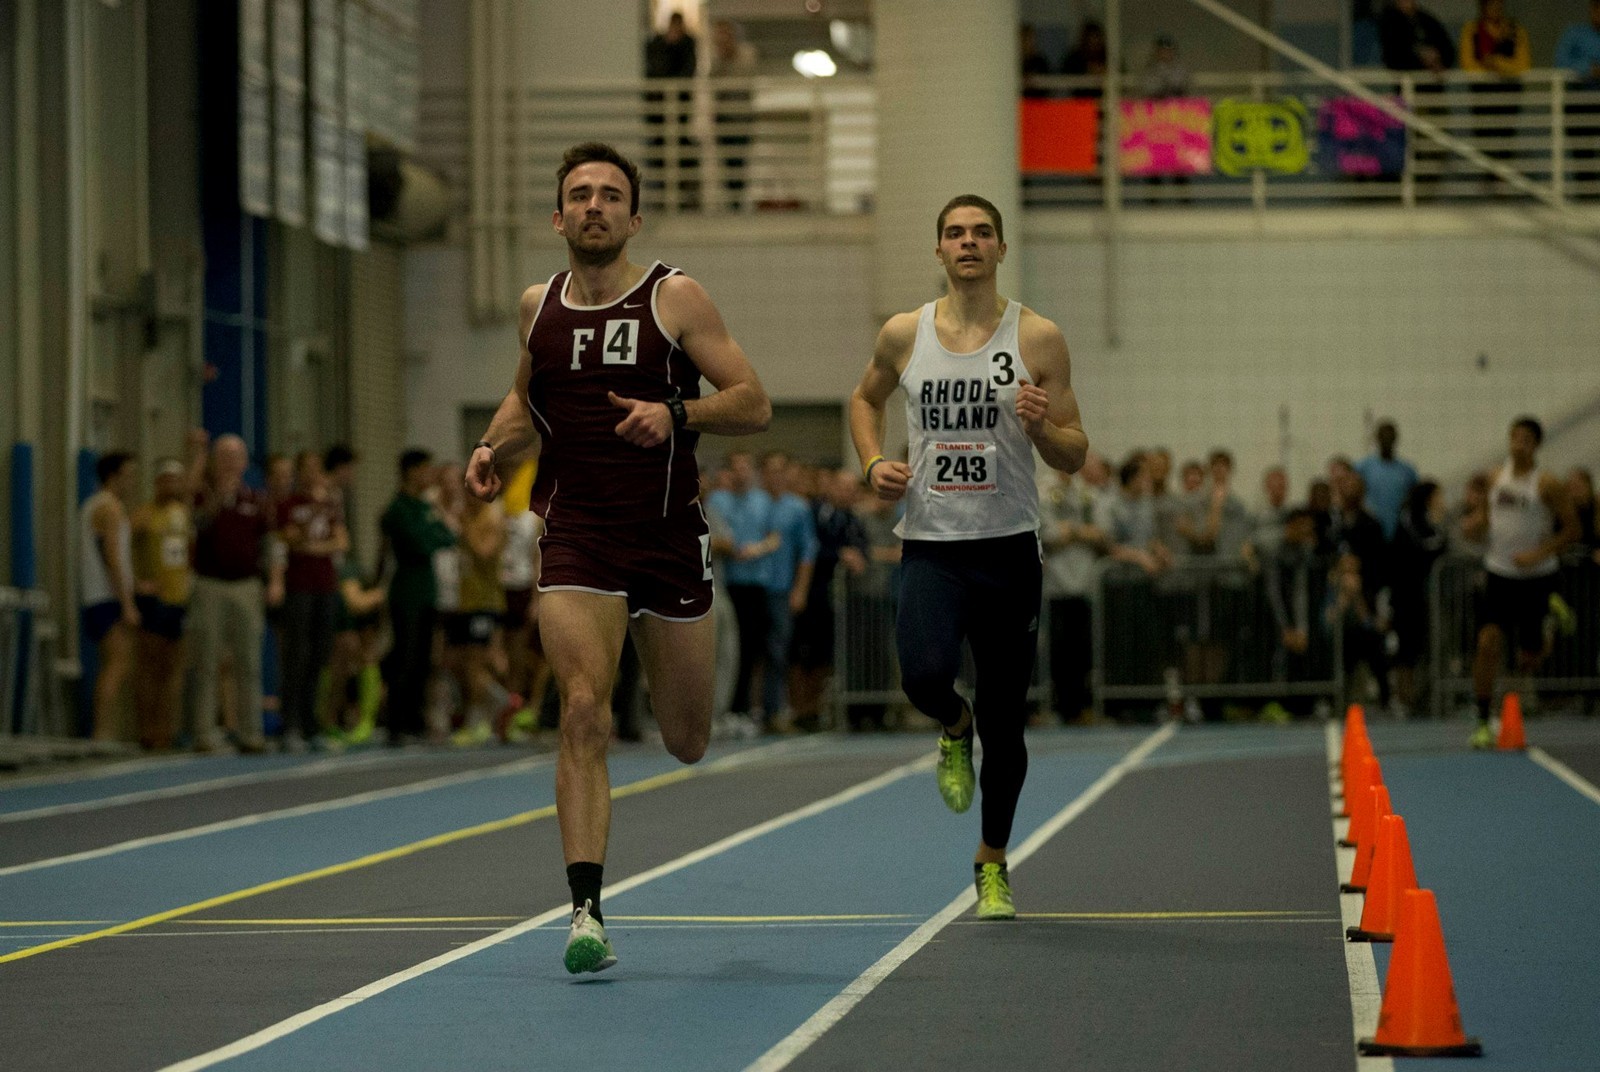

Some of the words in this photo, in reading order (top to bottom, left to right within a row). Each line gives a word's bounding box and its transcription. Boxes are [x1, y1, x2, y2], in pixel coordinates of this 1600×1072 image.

[570, 328, 595, 371] F
[606, 322, 632, 361] 4
[992, 351, 1015, 386] 3
[920, 378, 998, 404] RHODE
[921, 405, 999, 430] ISLAND
[936, 443, 973, 451] ATLANTIC
[975, 443, 985, 451] 10
[935, 455, 987, 483] 243
